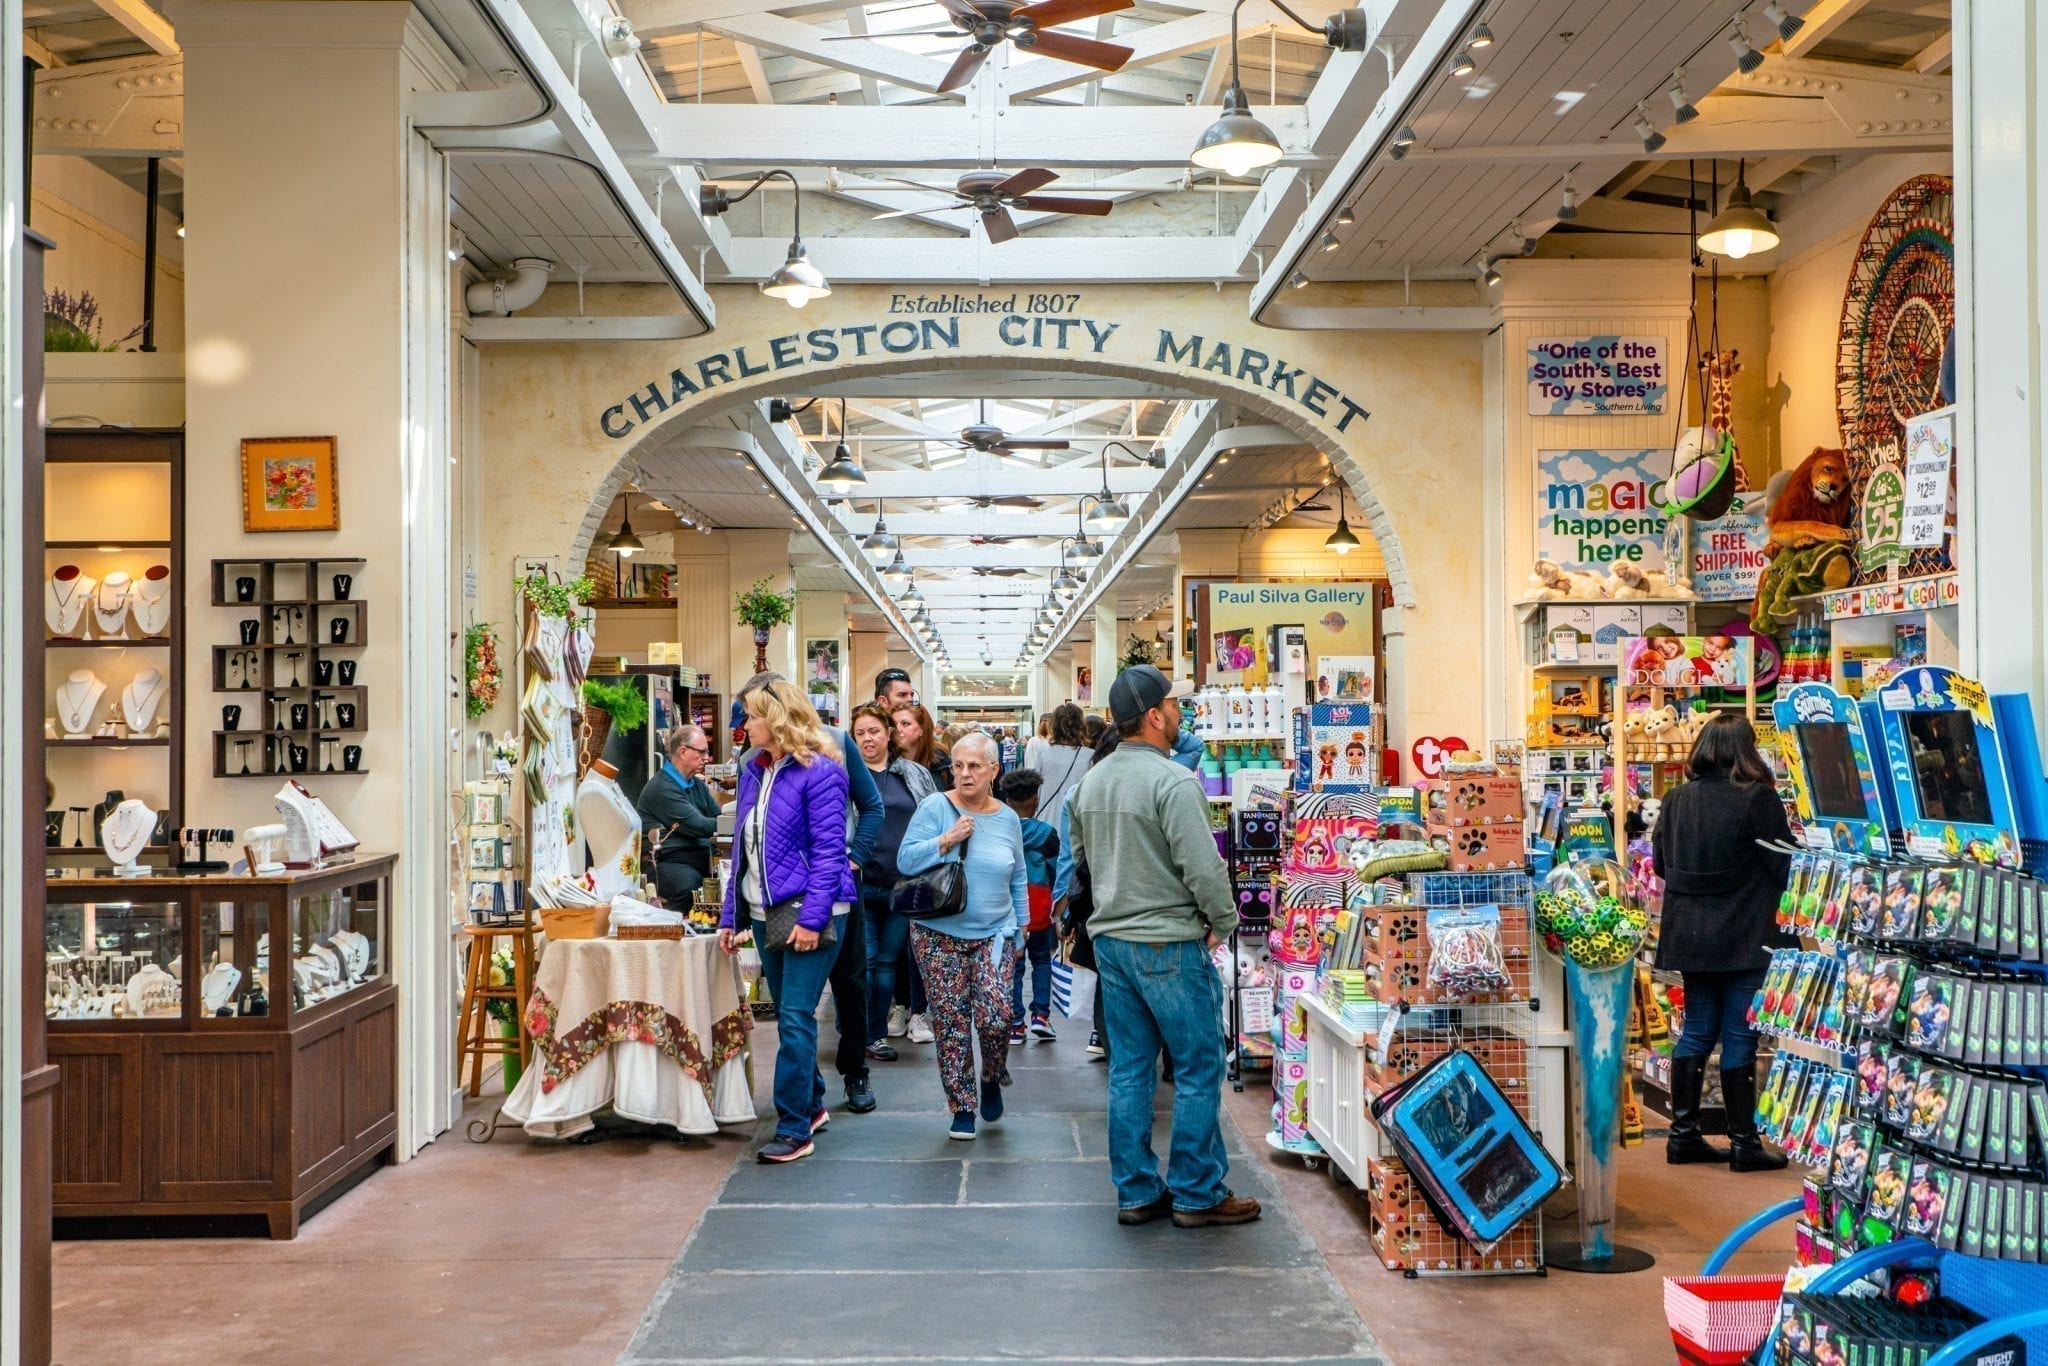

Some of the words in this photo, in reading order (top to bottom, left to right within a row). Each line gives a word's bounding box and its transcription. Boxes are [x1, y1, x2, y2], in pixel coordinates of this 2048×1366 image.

[889, 294, 1015, 314] Established
[1024, 294, 1080, 313] 1807
[1597, 342, 1618, 359] of
[1624, 342, 1656, 359] the
[600, 316, 960, 438] CHARLESTON
[999, 314, 1121, 353] CITY
[1154, 328, 1371, 434] MARKET
[1616, 362, 1661, 378] Best
[1538, 383, 1576, 400] Toy
[1594, 403, 1634, 411] Southern
[1635, 402, 1662, 412] Living
[1553, 514, 1668, 540] happens
[1720, 520, 1760, 533] offering
[1871, 502, 1899, 546] 25
[1712, 532, 1746, 551] FREE
[1578, 538, 1643, 563] here
[1695, 550, 1765, 572] SHIPPING
[1704, 572, 1732, 582] OVER
[1734, 571, 1756, 580] $99!
[1218, 590, 1255, 604] Paul
[1260, 589, 1300, 604] Silva
[1305, 588, 1365, 606] Gallery
[1825, 597, 1848, 613] LEGO
[1864, 593, 1890, 610] LEGO
[1907, 584, 1936, 605] LEGO
[1635, 669, 1735, 686] DOUGLAS
[1954, 684, 1985, 703] FEATURED
[1379, 797, 1413, 806] MOON
[1570, 823, 1603, 837] MOON
[1293, 979, 1302, 987] 12
[1292, 1067, 1301, 1075] 12
